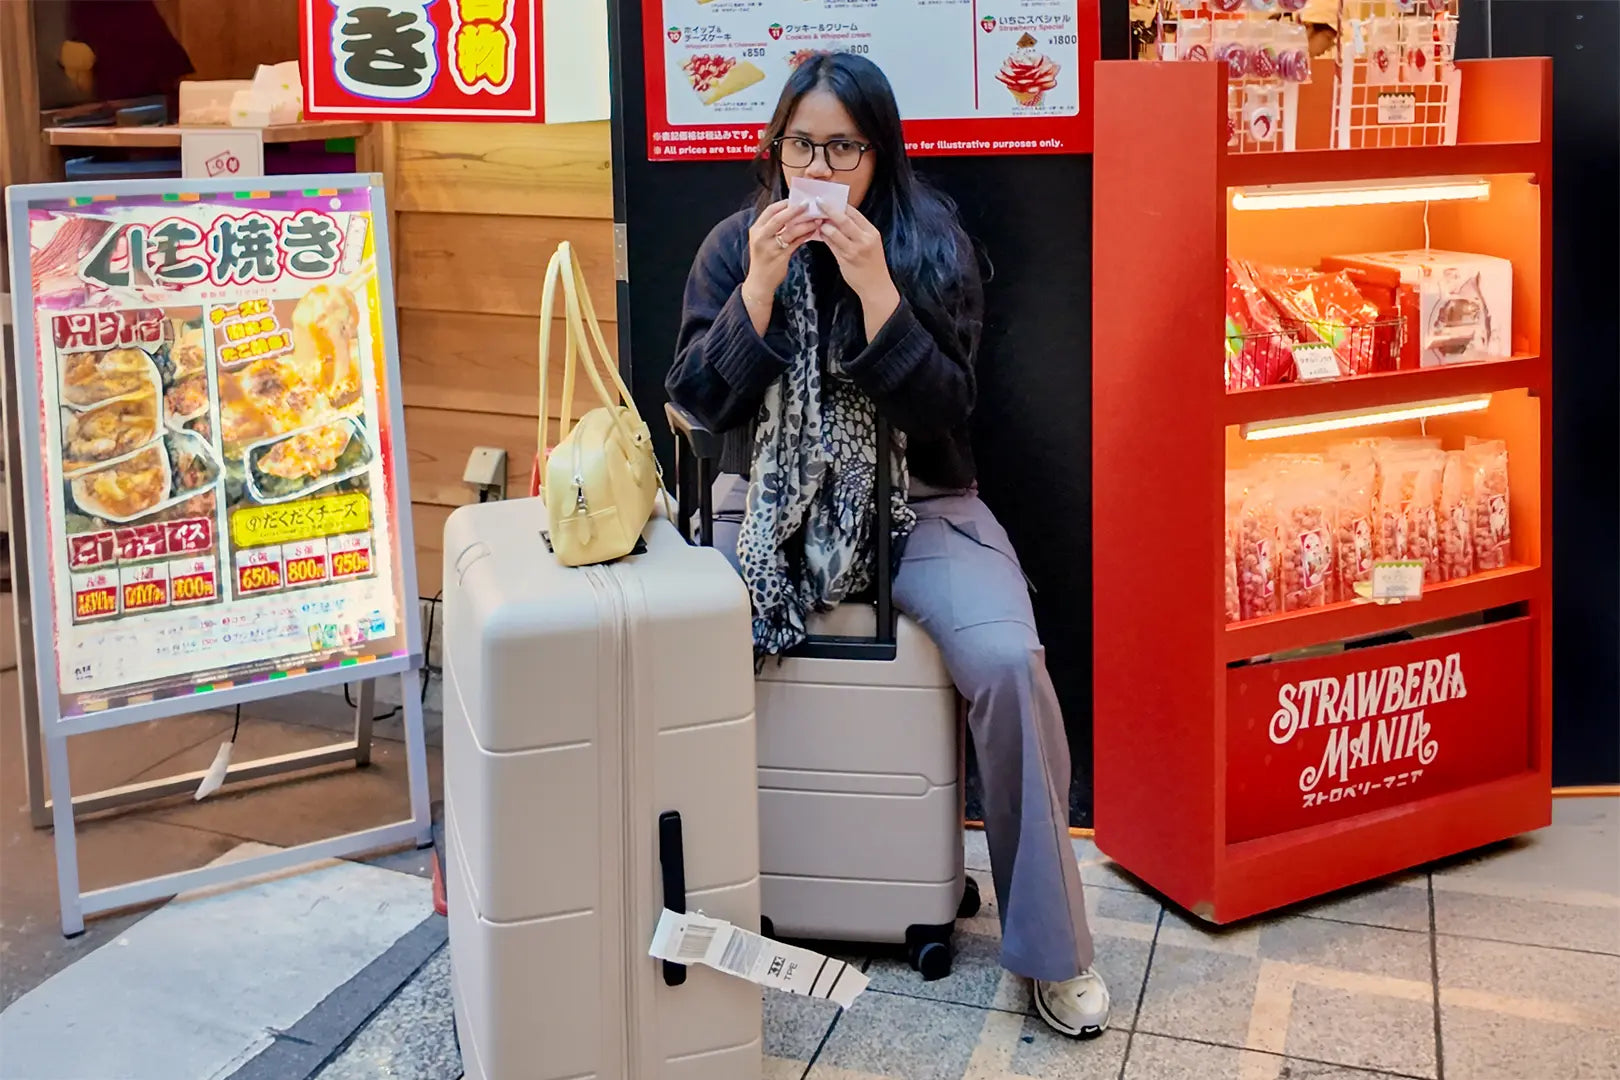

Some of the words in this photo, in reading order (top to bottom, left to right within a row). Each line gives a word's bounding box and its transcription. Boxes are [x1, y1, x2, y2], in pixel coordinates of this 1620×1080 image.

[664, 145, 677, 155] All
[678, 145, 708, 155] prices
[709, 146, 725, 154] are
[726, 145, 742, 153] tax
[920, 140, 935, 149] for
[937, 139, 990, 149] illustrative
[993, 139, 1037, 149] purposes
[1039, 138, 1064, 149] only.
[1299, 709, 1439, 792] MANIA
[1302, 769, 1424, 809] ストロベリーマニア
